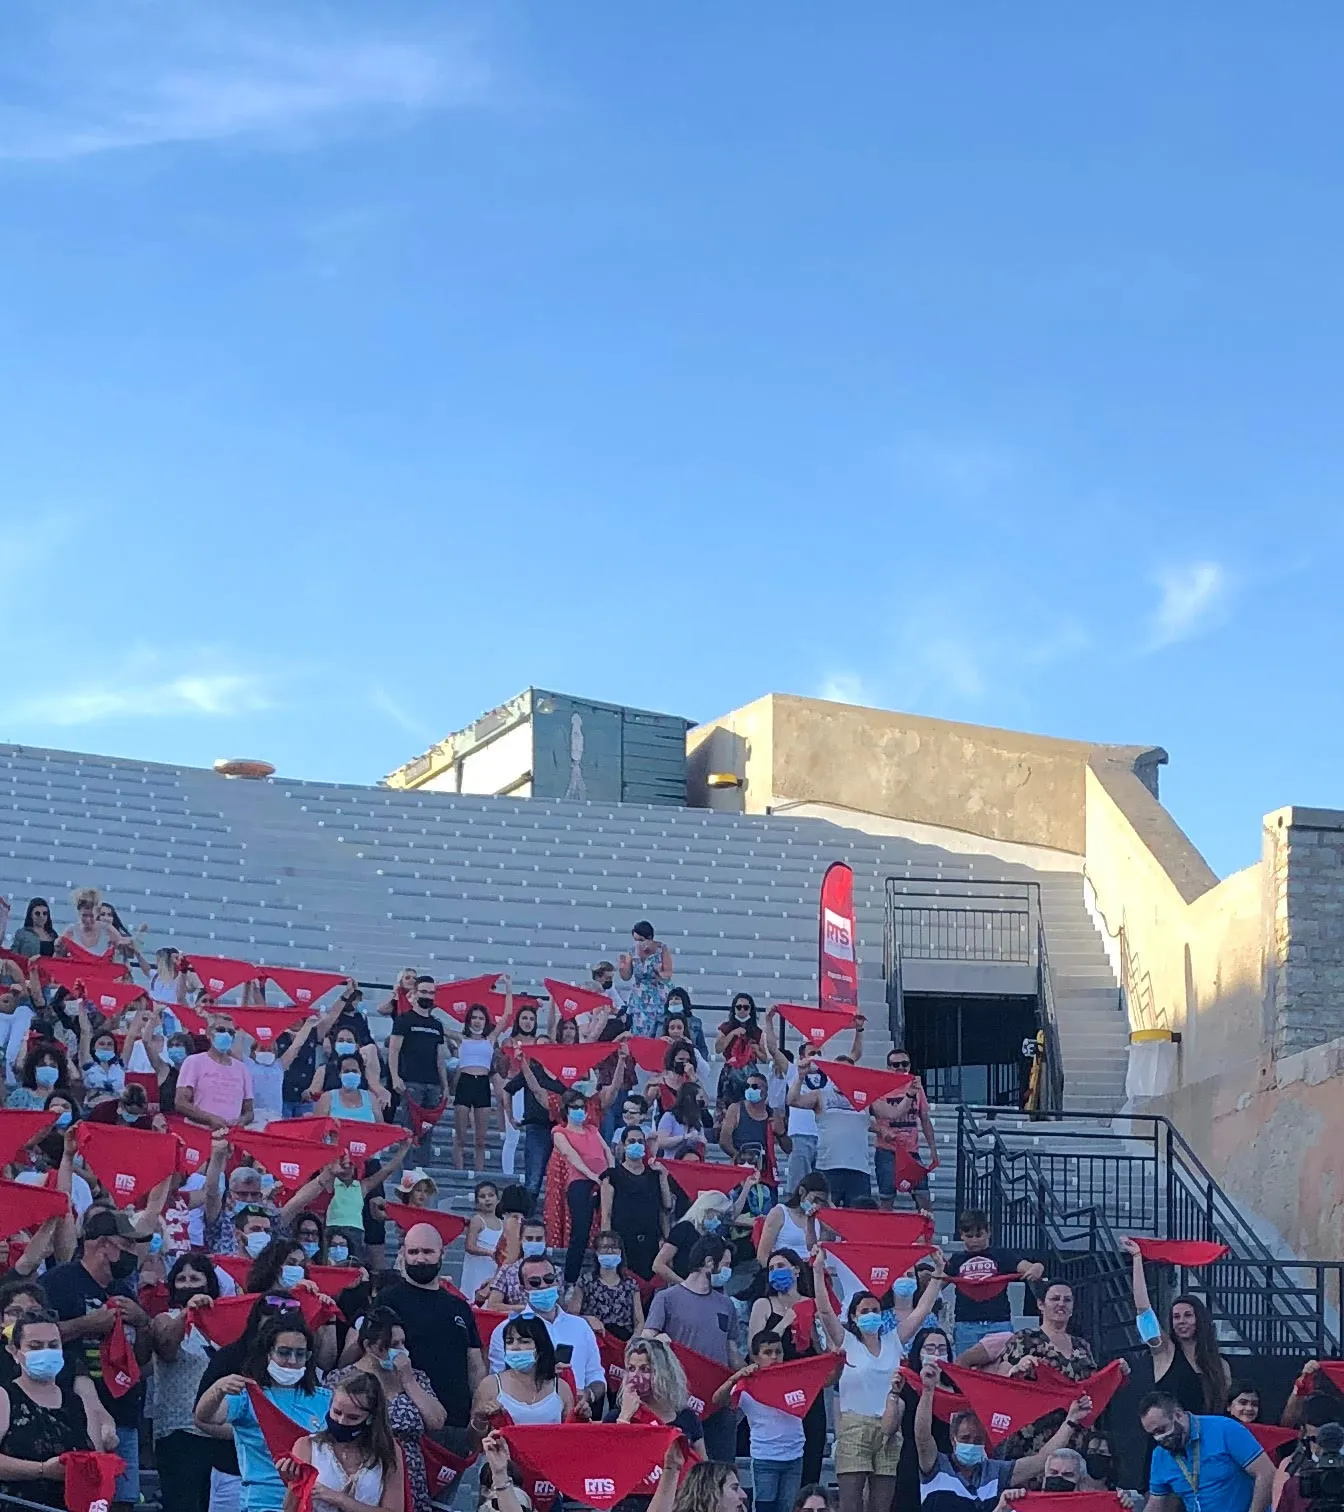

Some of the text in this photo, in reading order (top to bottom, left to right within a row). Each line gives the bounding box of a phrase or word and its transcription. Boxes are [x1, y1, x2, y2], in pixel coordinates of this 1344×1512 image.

[826, 920, 850, 945] RTS
[115, 1173, 137, 1188] RTS
[959, 1262, 997, 1274] PETROL
[784, 1389, 806, 1404] RTS
[991, 1412, 1012, 1426] RTS
[437, 1465, 457, 1480] RTS
[534, 1480, 556, 1494] RTS
[585, 1478, 615, 1494] RTS
